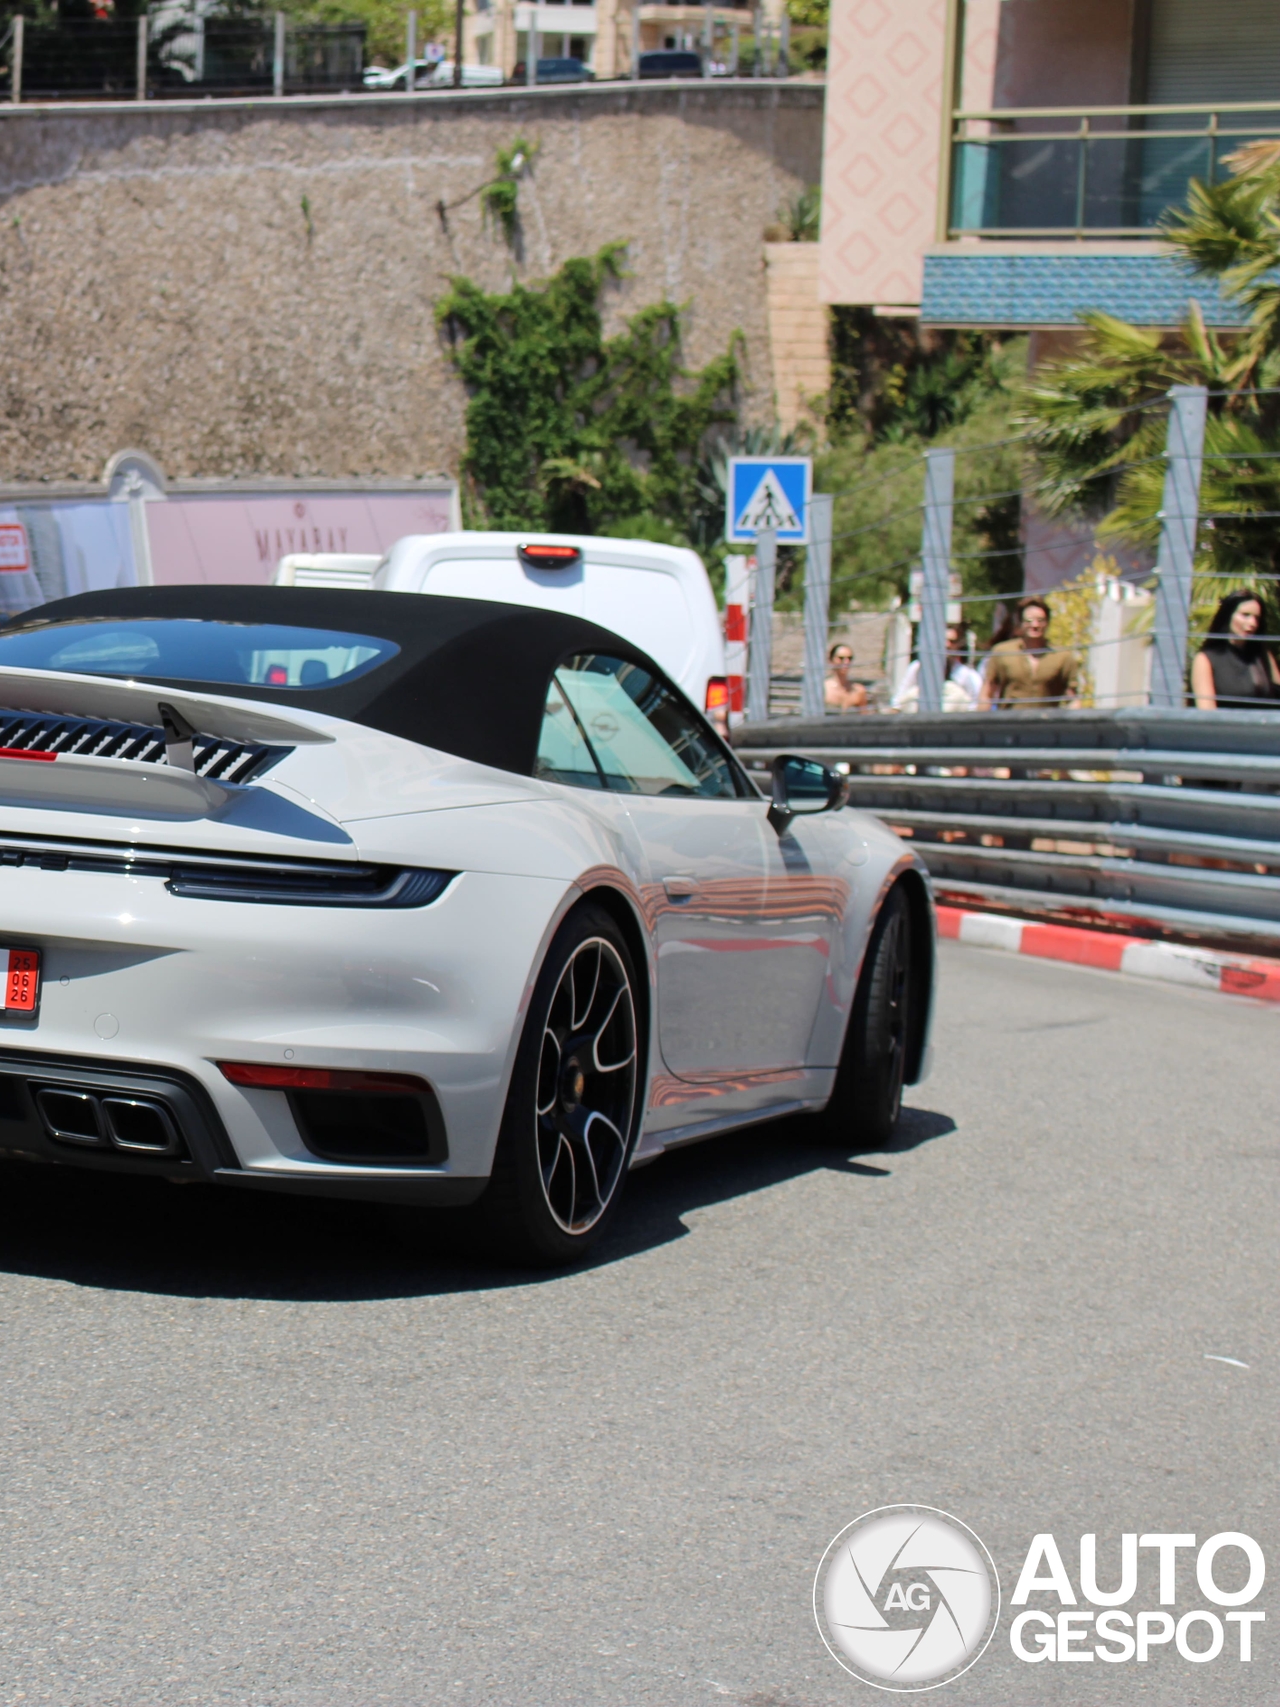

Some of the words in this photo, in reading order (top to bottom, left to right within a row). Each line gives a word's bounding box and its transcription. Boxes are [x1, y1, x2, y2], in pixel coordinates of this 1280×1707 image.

[14, 957, 31, 970] 25
[12, 973, 29, 987] 06
[10, 989, 28, 1002] 26
